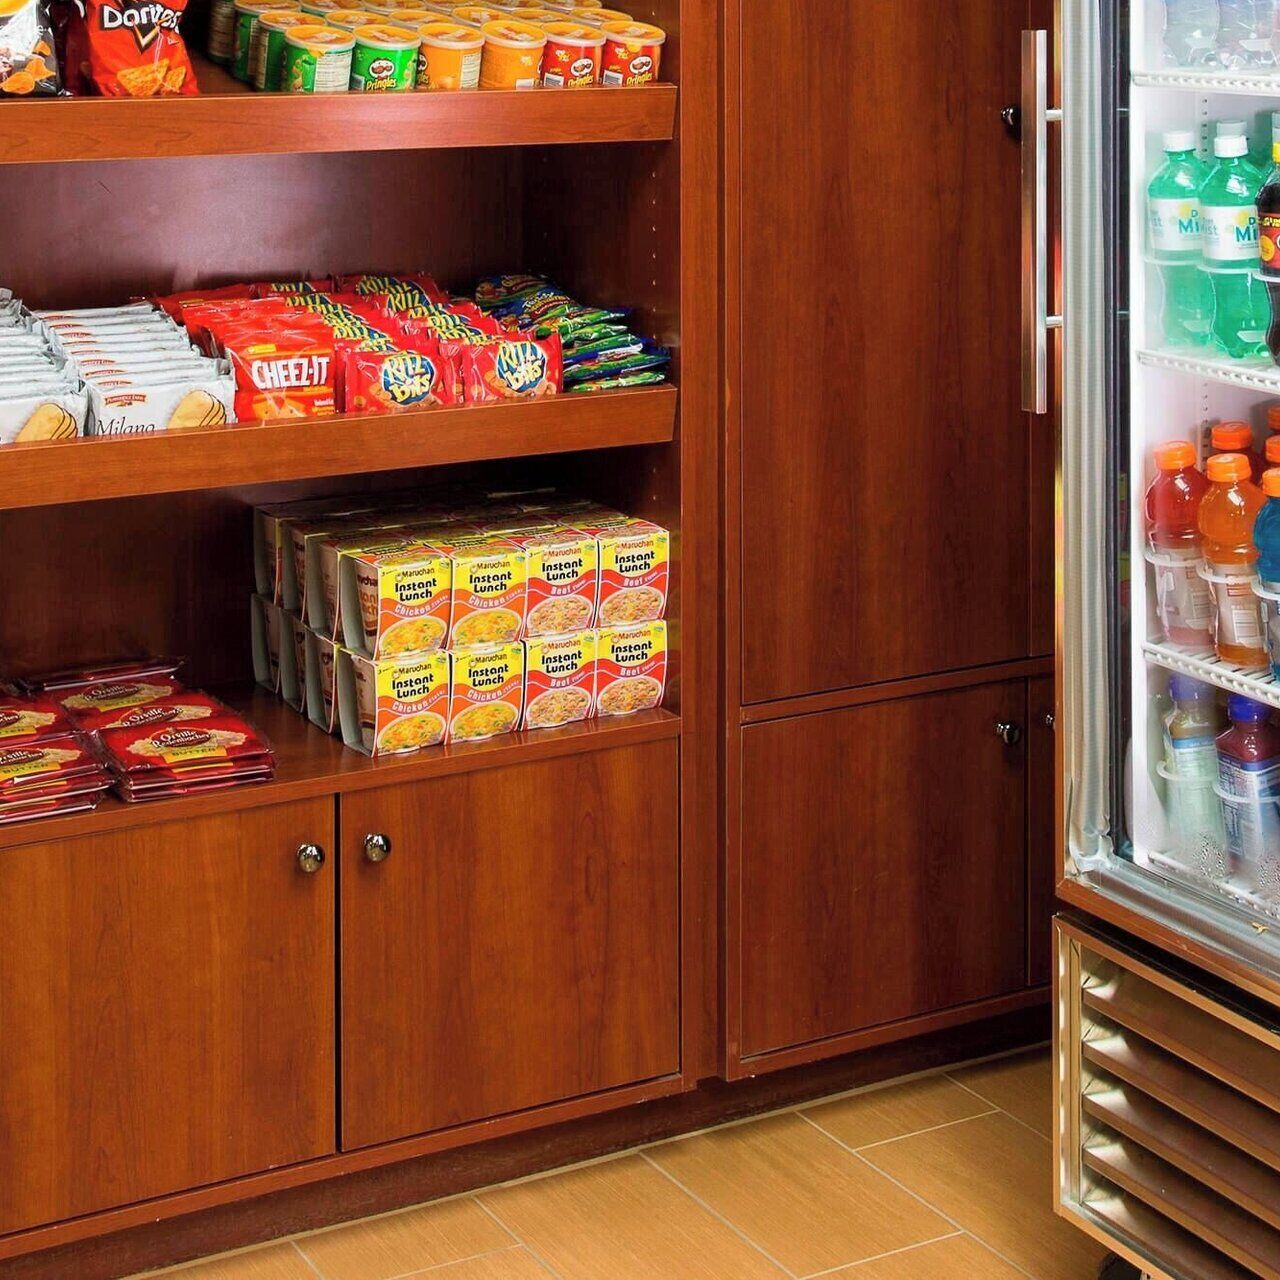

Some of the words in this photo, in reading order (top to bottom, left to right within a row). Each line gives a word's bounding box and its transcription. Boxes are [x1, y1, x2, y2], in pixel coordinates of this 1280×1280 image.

[366, 79, 397, 91] Pringles
[500, 339, 536, 365] RITZ
[251, 355, 330, 390] CHEEZ-IT
[387, 353, 426, 379] RITZ
[96, 417, 155, 436] Milano
[621, 539, 654, 550] Maruchan
[548, 547, 582, 558] Maruchan
[615, 550, 655, 564] Instant
[477, 560, 510, 571] Maruchan
[542, 558, 583, 573] Instant
[619, 561, 651, 573] Lunch
[401, 567, 435, 579] Maruchan
[469, 571, 512, 584] Instant
[546, 569, 578, 581] Lunch
[394, 578, 437, 593] Instant
[474, 581, 507, 594] Lunch
[400, 589, 432, 602] Lunch
[469, 595, 505, 608] Chicken
[394, 603, 431, 617] Chicken
[618, 629, 652, 640] Maruchan
[548, 639, 581, 650] Maruchan
[611, 640, 652, 654] Instant
[476, 652, 507, 663] Maruchan
[541, 650, 582, 665] Instant
[615, 651, 648, 663] Lunch
[398, 663, 432, 674] Maruchan
[468, 664, 509, 677] Instant
[546, 661, 578, 674] Lunch
[392, 673, 434, 689] Instant
[472, 675, 504, 687] Lunch
[397, 685, 430, 699] Lunch
[467, 688, 503, 702] Chicken
[392, 700, 429, 713] Chicken
